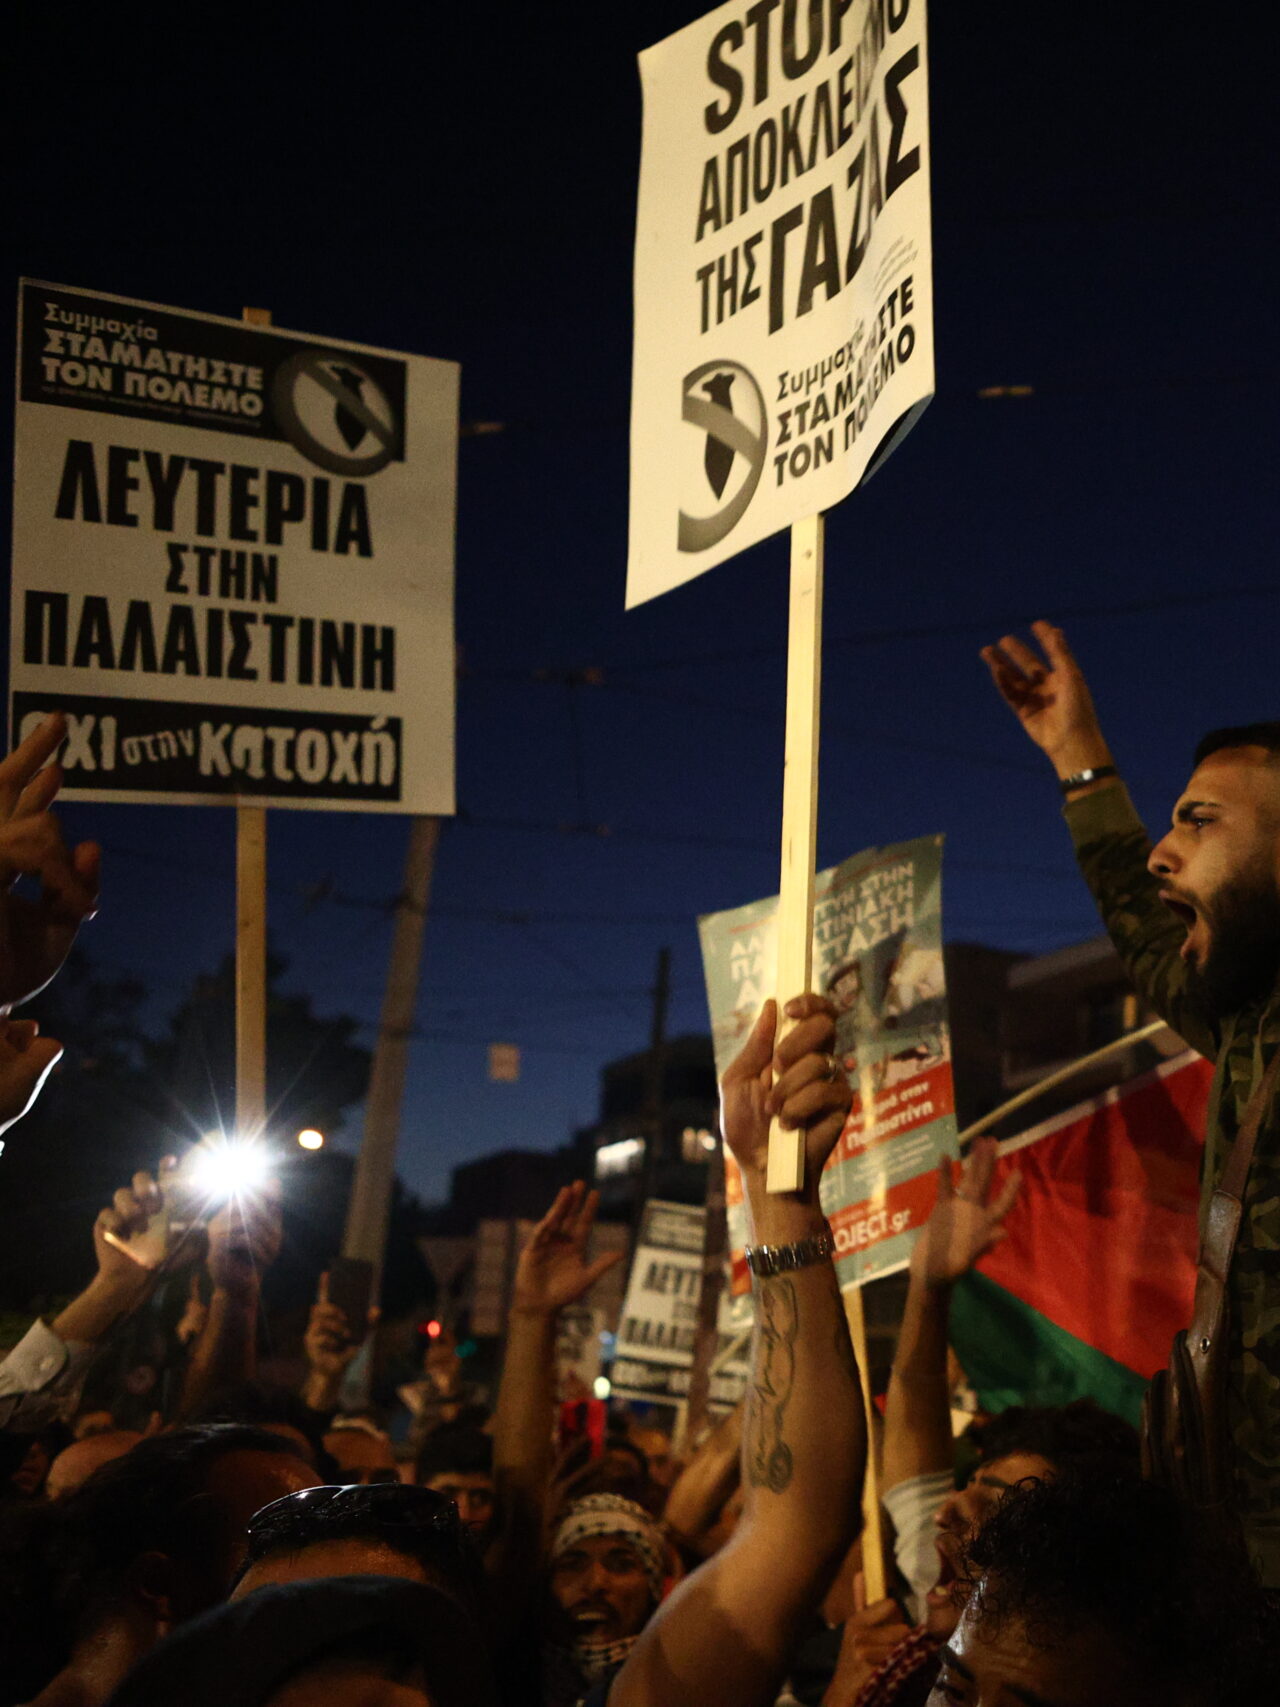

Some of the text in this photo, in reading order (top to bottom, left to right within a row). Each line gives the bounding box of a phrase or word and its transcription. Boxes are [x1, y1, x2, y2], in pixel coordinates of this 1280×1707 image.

[696, 230, 763, 336] ΤΗΣ
[44, 302, 159, 342] Συμμαχία
[41, 356, 113, 391] ΤΟΝ
[124, 371, 264, 417] ΠΟΛΕΜΟ
[43, 328, 264, 390] ΣΤΑΜΑΤΗΣΤΕ
[776, 318, 865, 402] Συμμαχ
[773, 427, 834, 488] ΤΟΝ
[54, 439, 374, 559] ΛΕΥΤΕΡΙΑ
[164, 541, 279, 604] ΣΤΗΝ
[23, 589, 396, 692] ΠΑΛΑΙΣΤΙΝΗ
[121, 728, 195, 766] στην
[199, 713, 397, 787] Κατοχή
